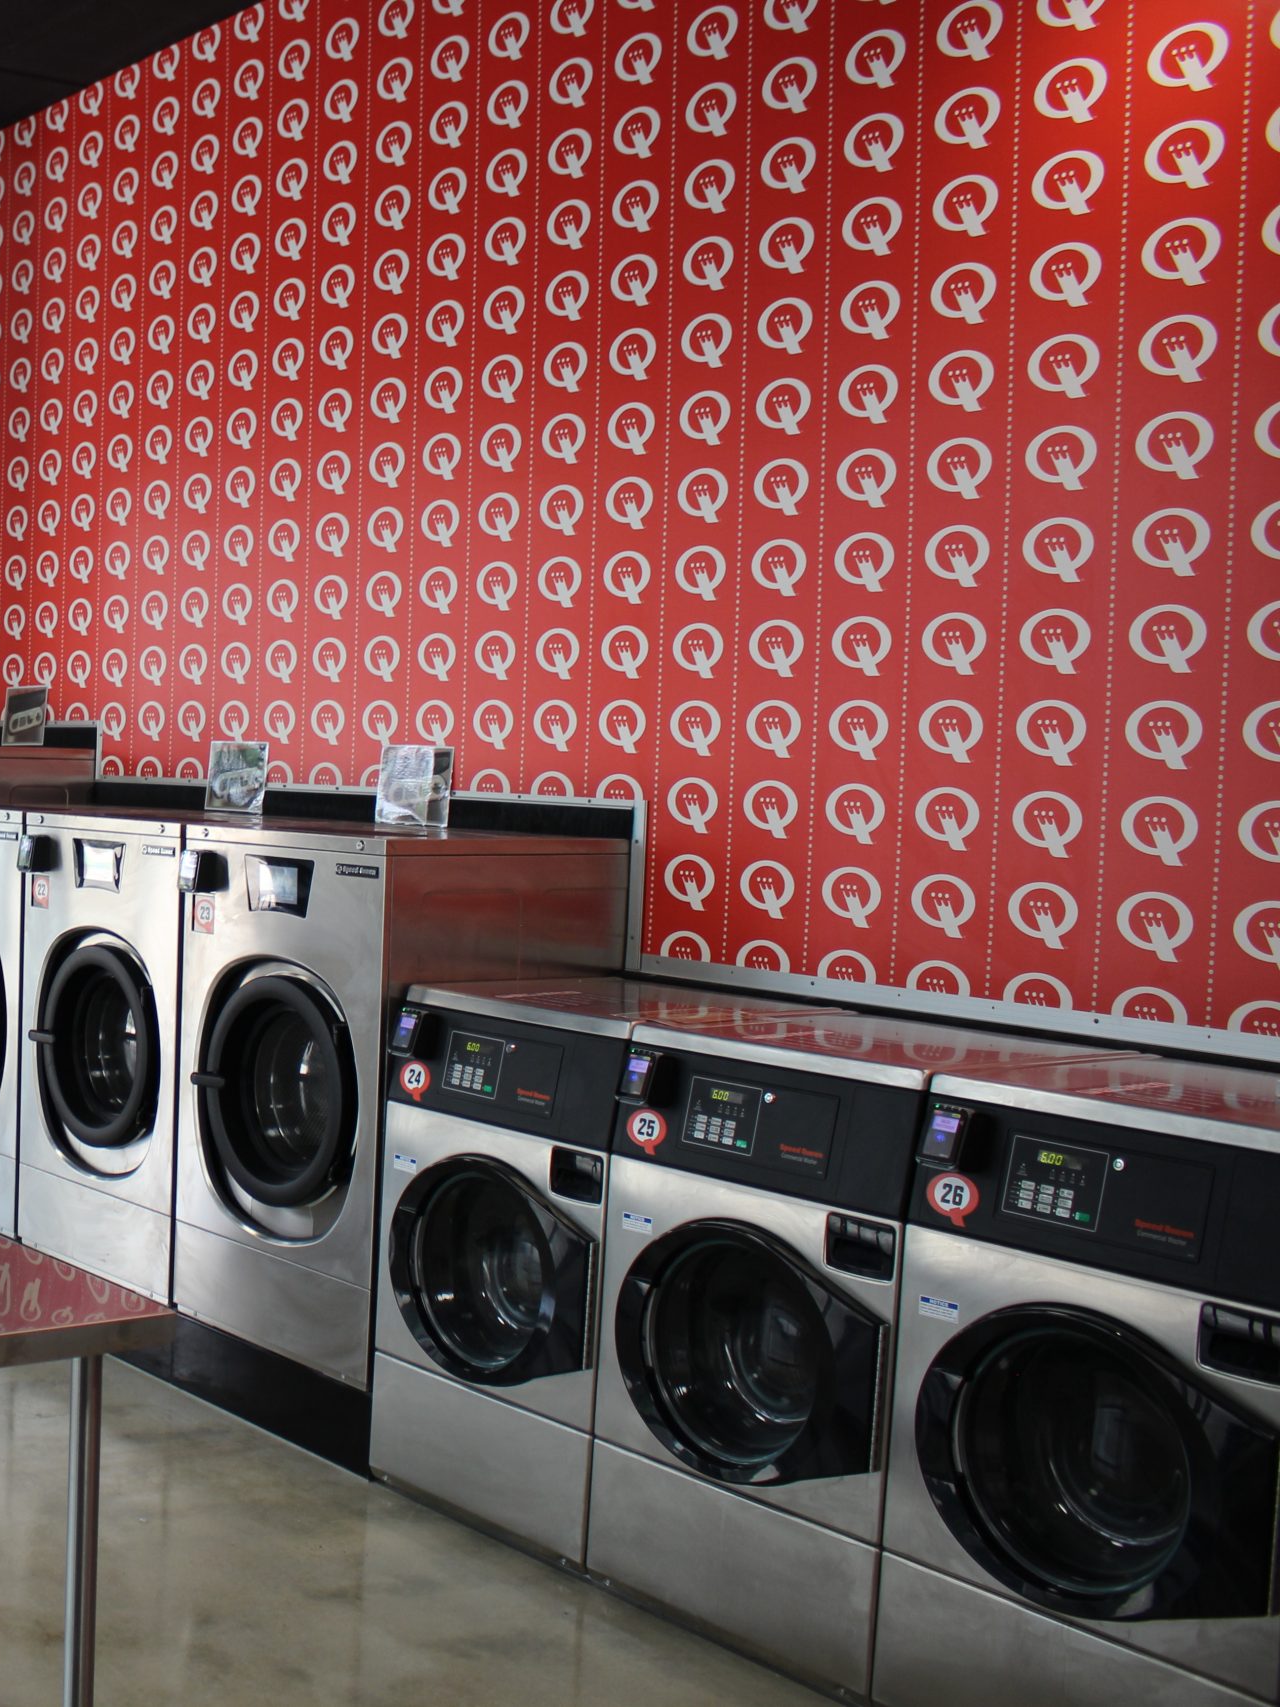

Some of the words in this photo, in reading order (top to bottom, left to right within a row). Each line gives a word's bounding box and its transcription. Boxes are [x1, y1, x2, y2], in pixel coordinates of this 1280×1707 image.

[37, 884, 46, 897] 22
[200, 905, 211, 921] 23
[407, 1068, 422, 1086] 24
[637, 1117, 656, 1138] 25
[1040, 1152, 1064, 1166] 6.00
[940, 1182, 965, 1207] 26
